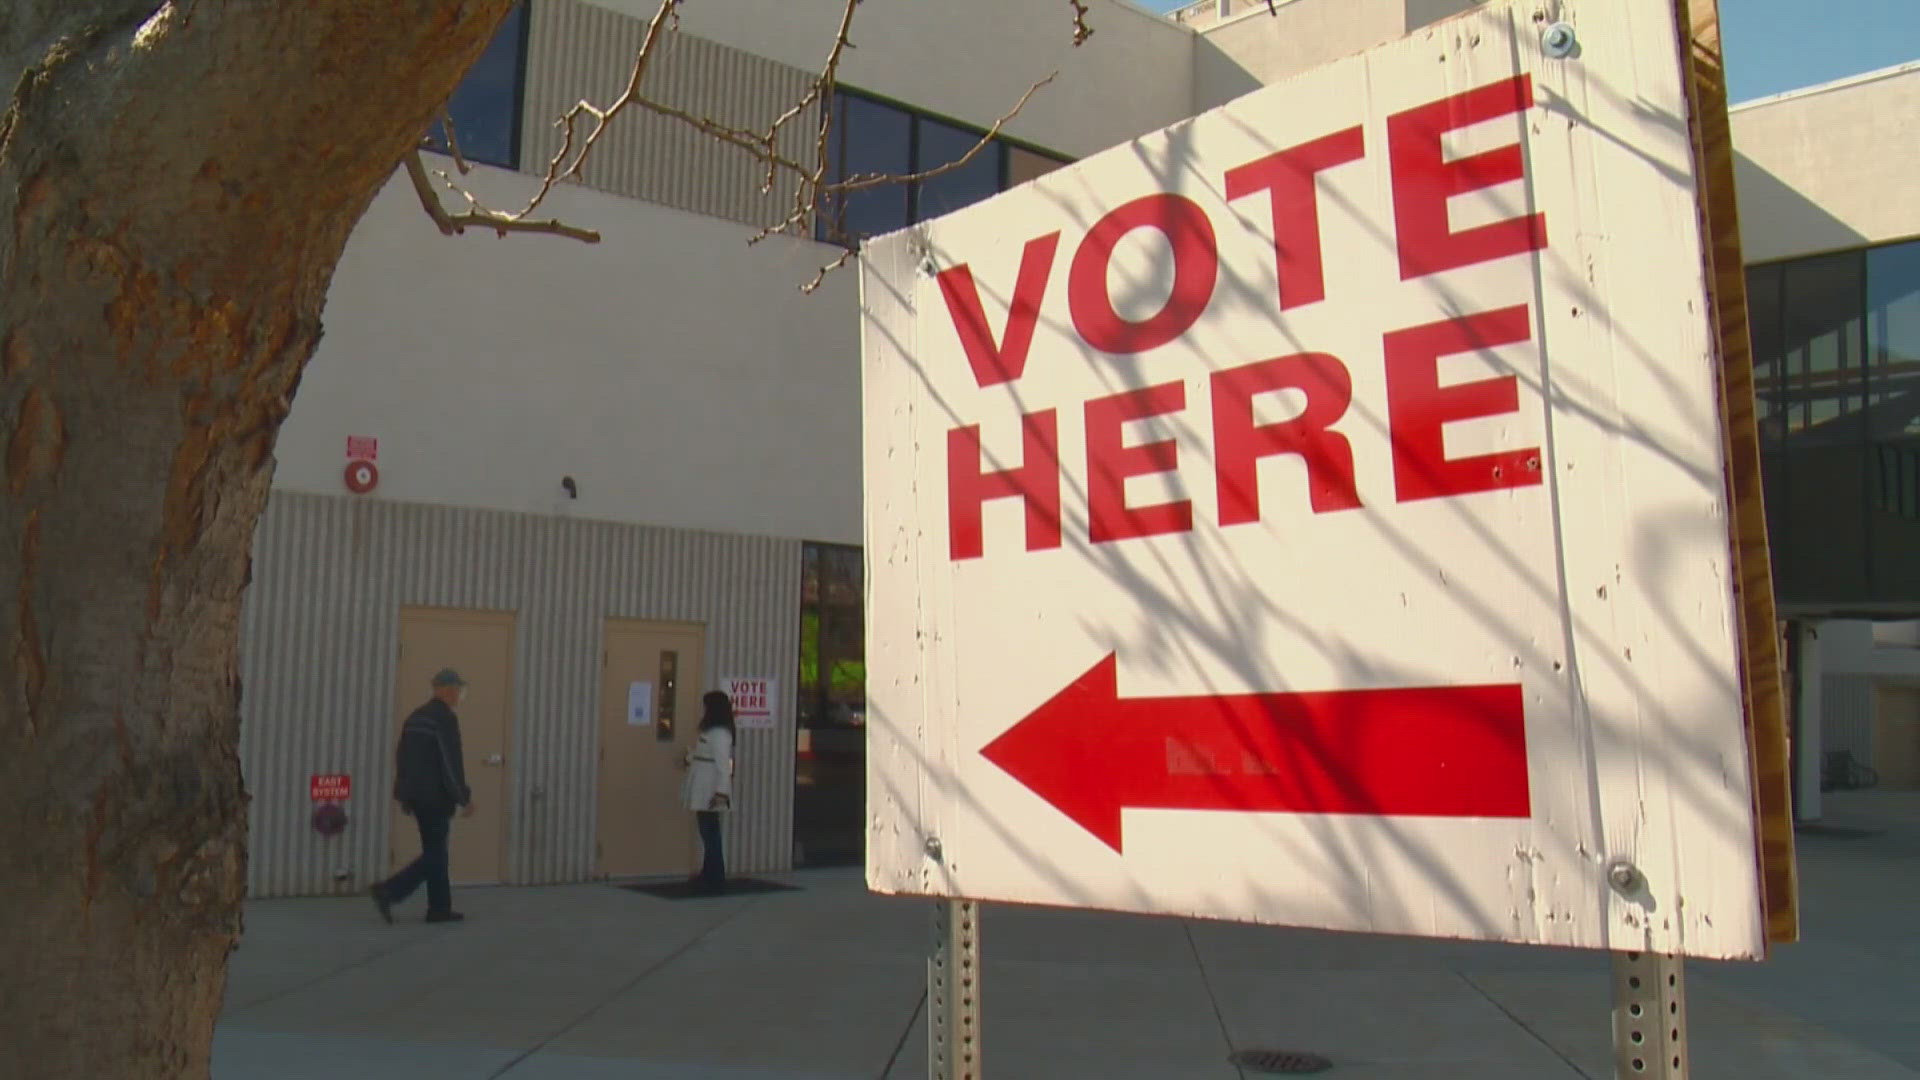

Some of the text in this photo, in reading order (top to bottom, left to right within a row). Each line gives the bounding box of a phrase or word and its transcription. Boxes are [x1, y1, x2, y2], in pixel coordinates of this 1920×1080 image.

[937, 73, 1548, 388] VOTE
[947, 304, 1543, 561] HERE
[730, 695, 768, 708] HERE
[731, 681, 768, 694] VOTE
